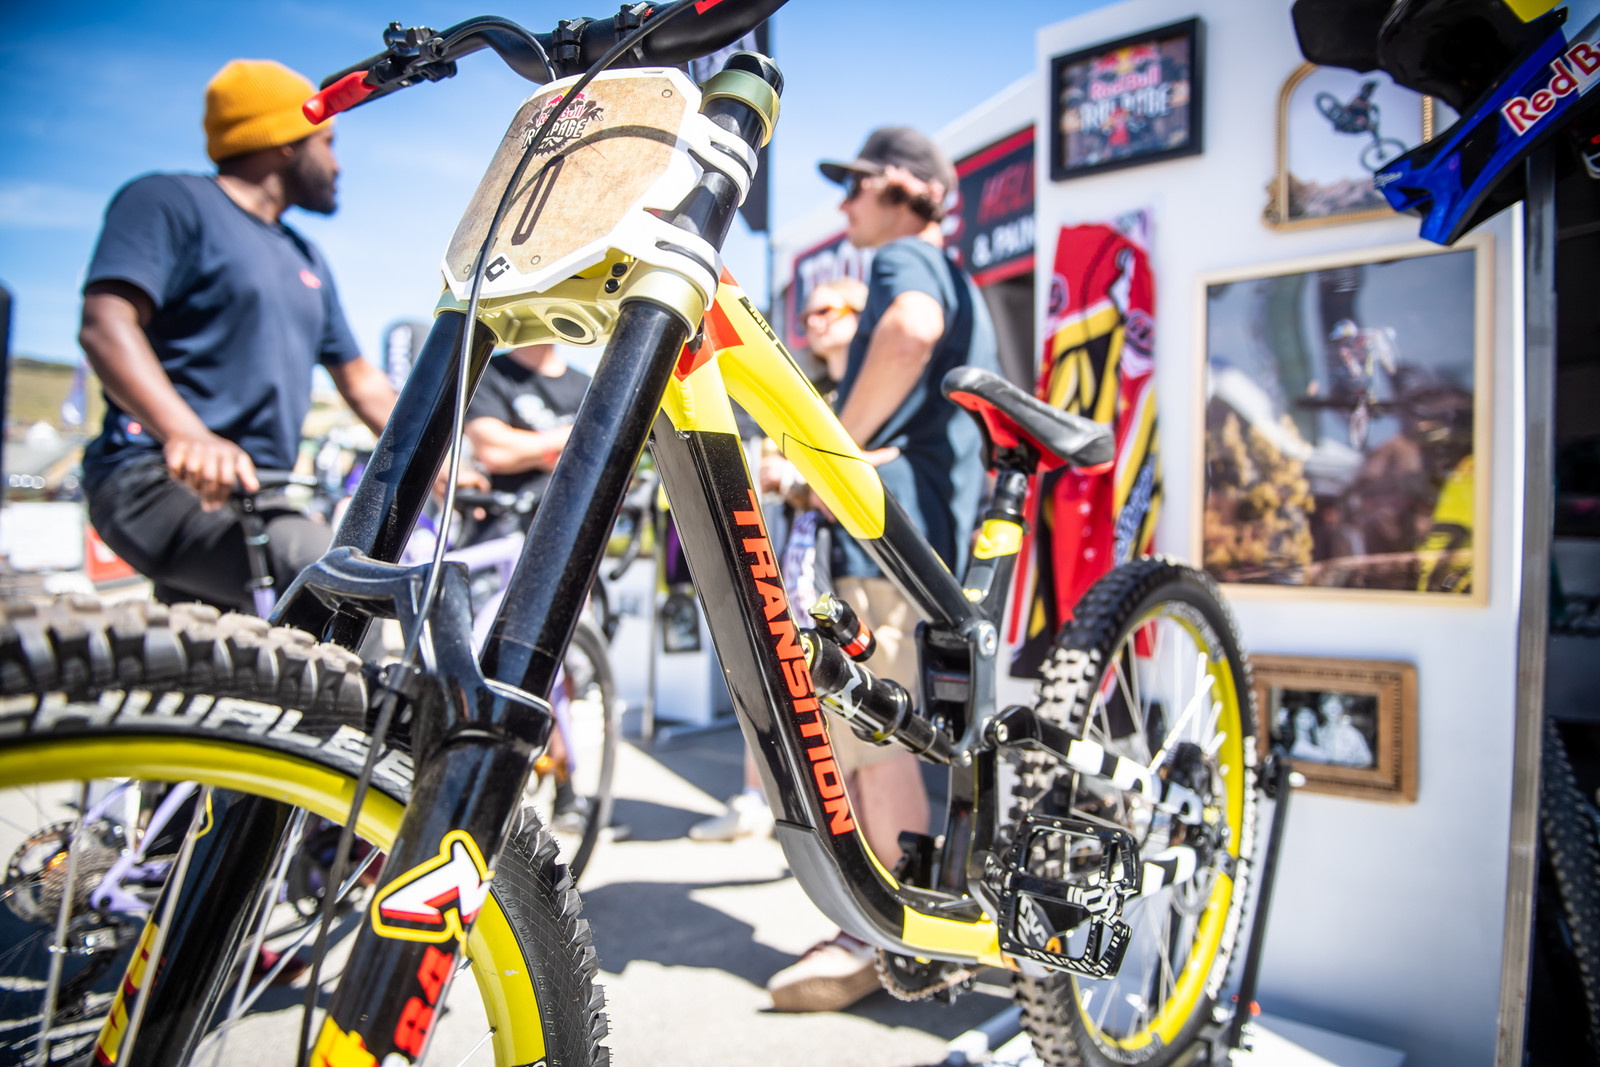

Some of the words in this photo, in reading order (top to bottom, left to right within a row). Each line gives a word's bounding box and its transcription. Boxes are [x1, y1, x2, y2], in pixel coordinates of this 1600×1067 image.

[521, 118, 588, 148] RPAGE
[1504, 58, 1579, 135] Red
[733, 488, 856, 835] TRANSITION
